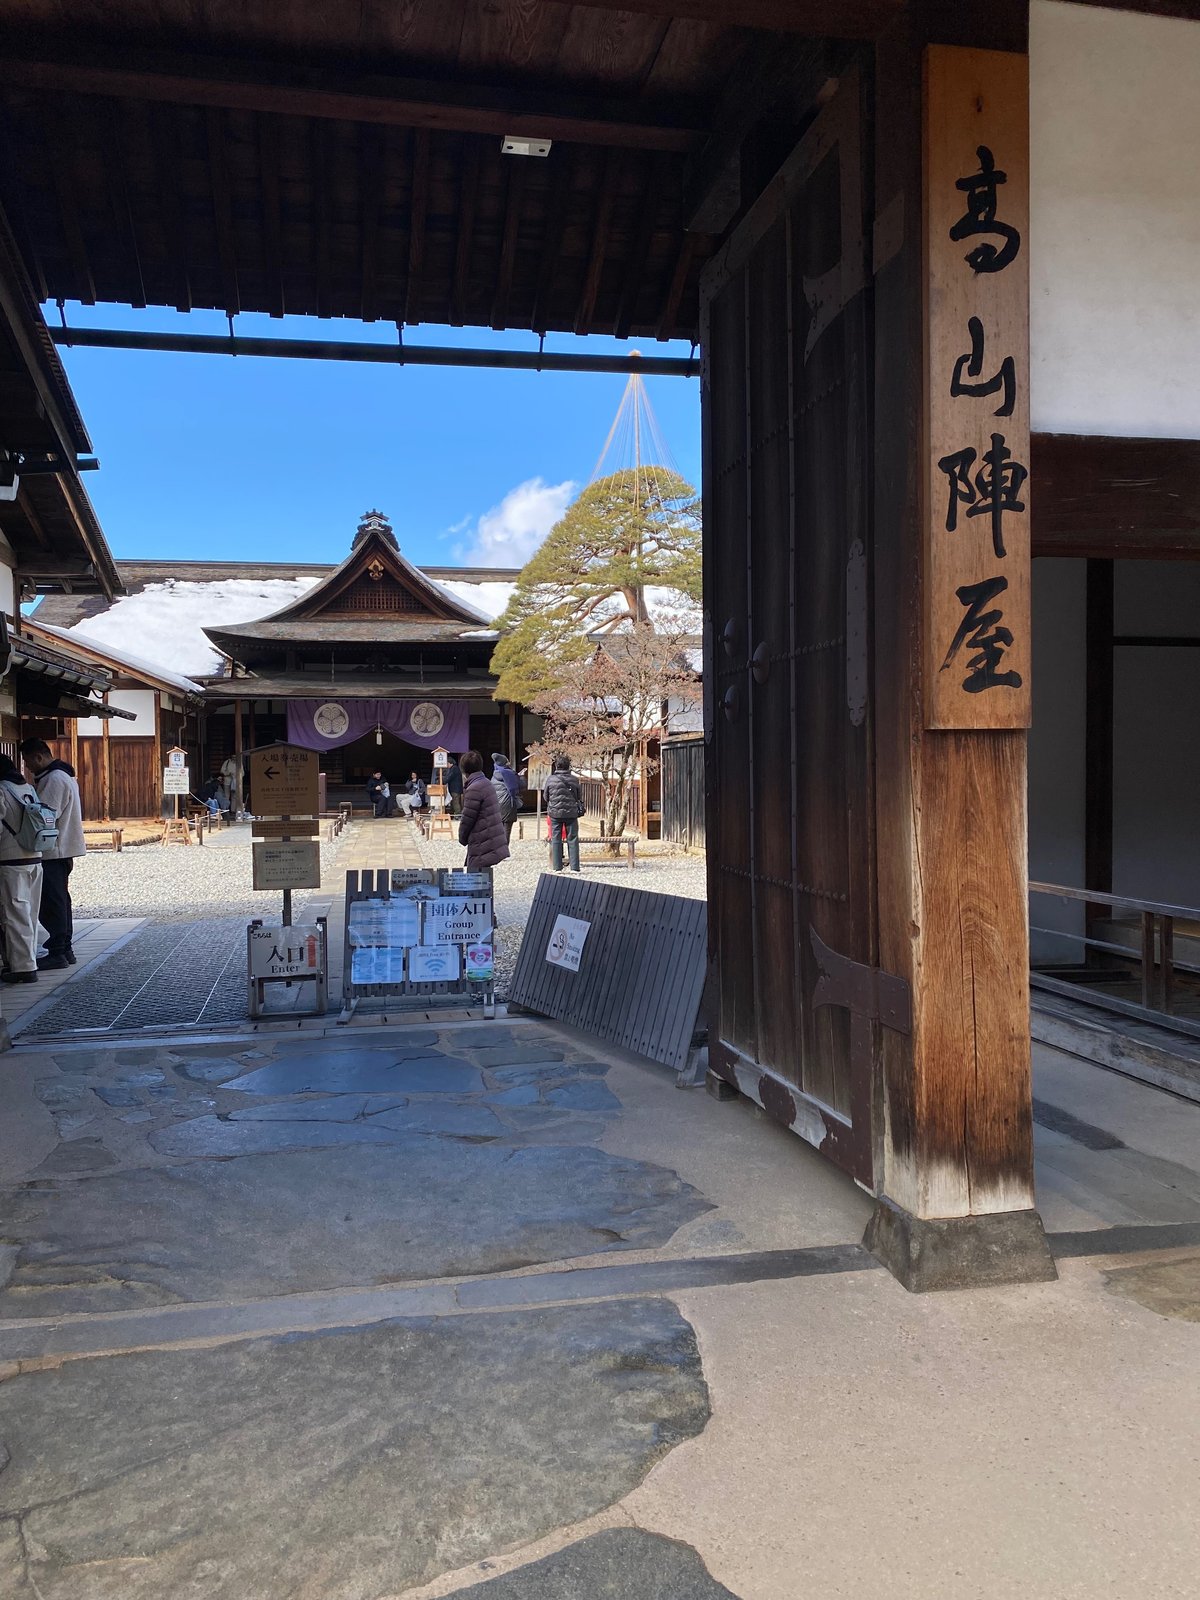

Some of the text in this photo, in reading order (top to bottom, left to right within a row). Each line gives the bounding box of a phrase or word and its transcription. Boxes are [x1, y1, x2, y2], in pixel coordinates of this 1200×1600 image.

[938, 146, 1028, 694] 高山陣屋
[431, 903, 486, 916] 団体入口
[445, 921, 474, 929] Group
[438, 932, 481, 940] Entrance
[265, 945, 304, 963] 入口
[271, 965, 300, 973] Enter
